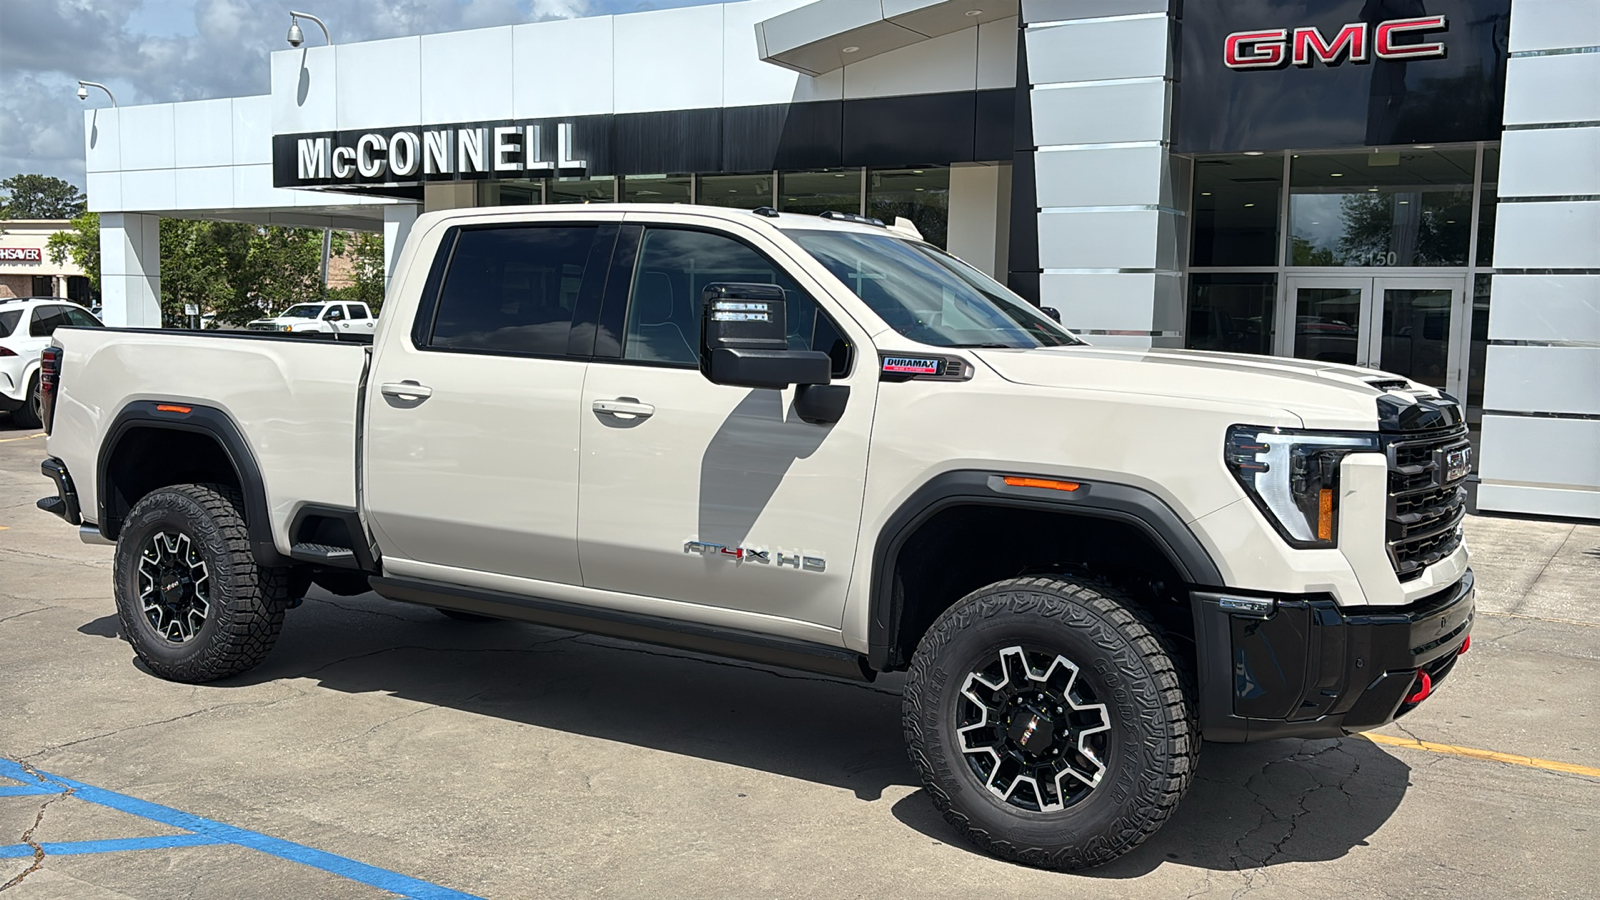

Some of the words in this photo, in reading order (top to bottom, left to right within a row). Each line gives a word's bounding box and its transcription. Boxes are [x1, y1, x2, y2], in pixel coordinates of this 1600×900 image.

[1224, 15, 1446, 68] GMC
[297, 123, 587, 179] McCONNELL
[1356, 251, 1397, 266] 3150
[887, 358, 934, 368] DURAMAX
[684, 541, 771, 562] AT4X
[777, 552, 826, 571] HD
